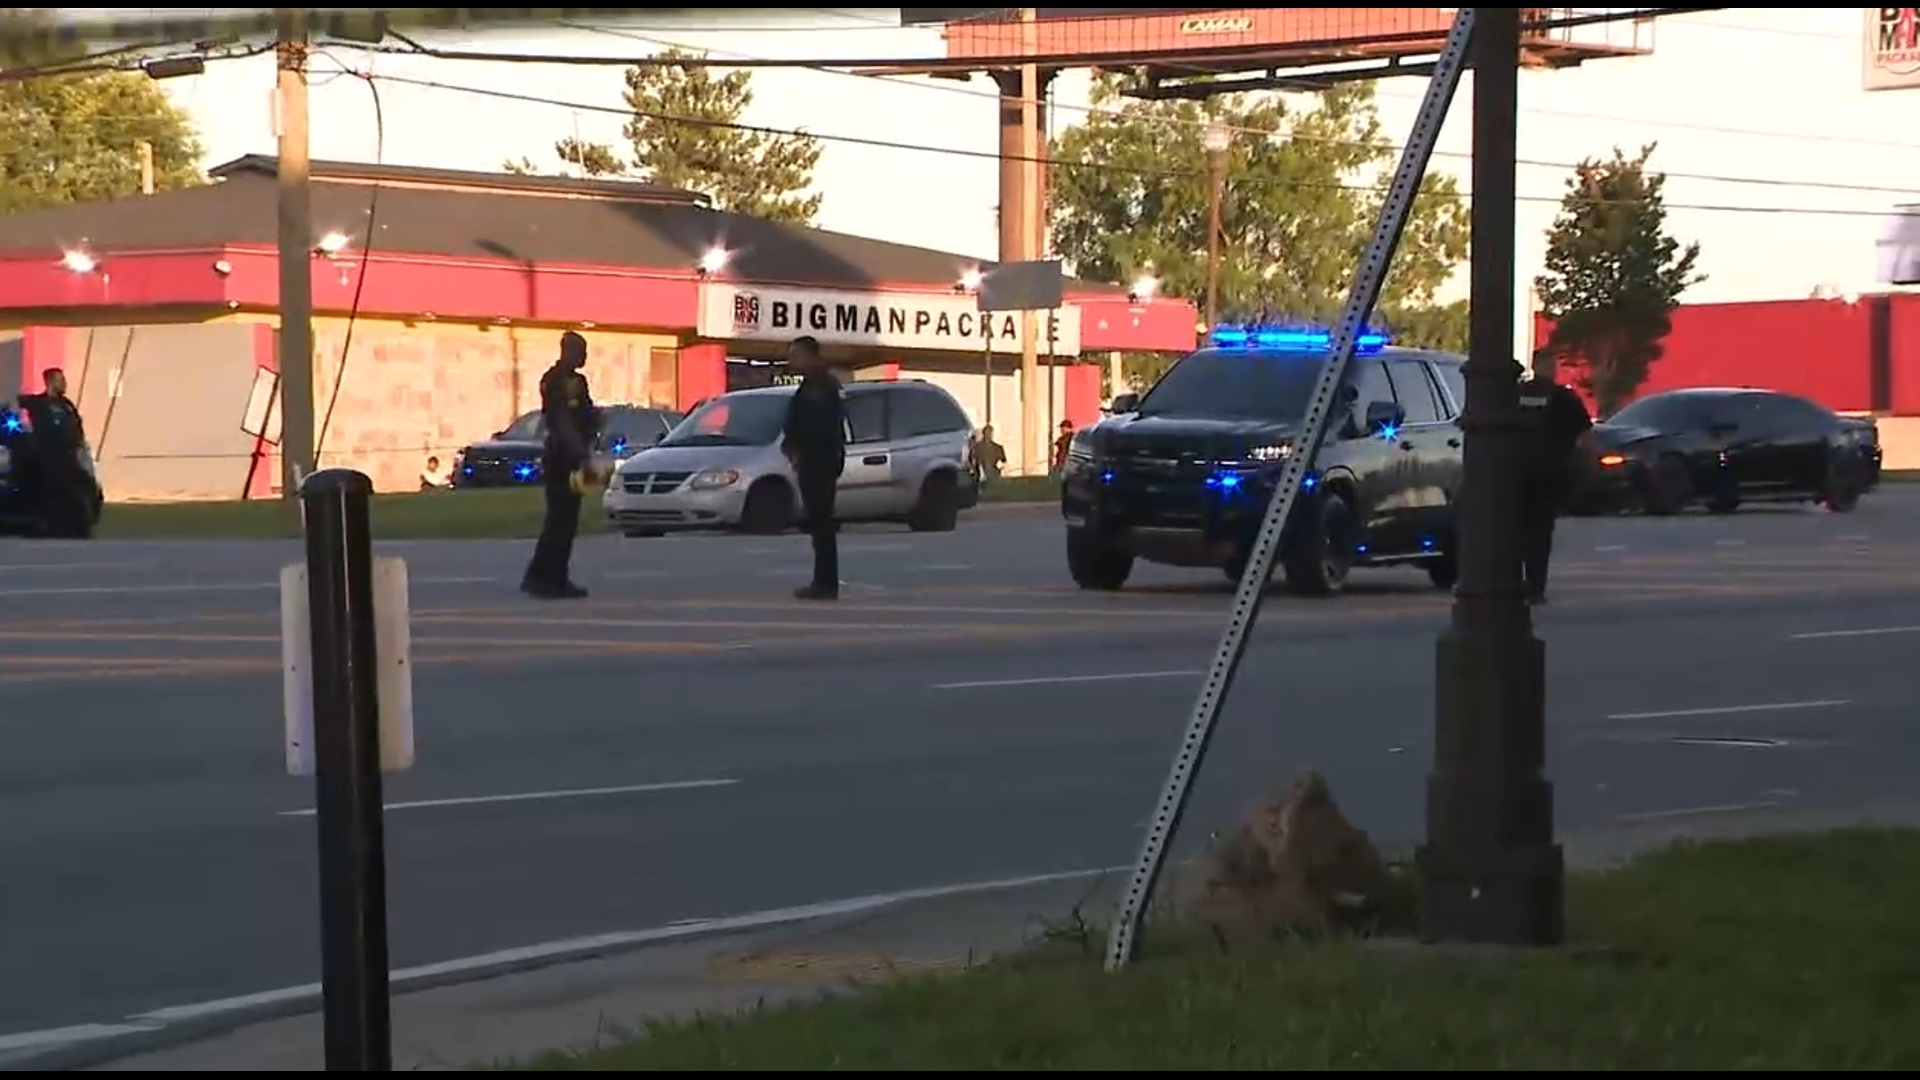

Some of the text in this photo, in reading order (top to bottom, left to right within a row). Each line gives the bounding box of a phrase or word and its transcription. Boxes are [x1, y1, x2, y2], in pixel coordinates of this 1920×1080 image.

[1182, 18, 1253, 33] LAMAR
[735, 296, 759, 310] BIG
[915, 310, 1059, 342] PACKAE
